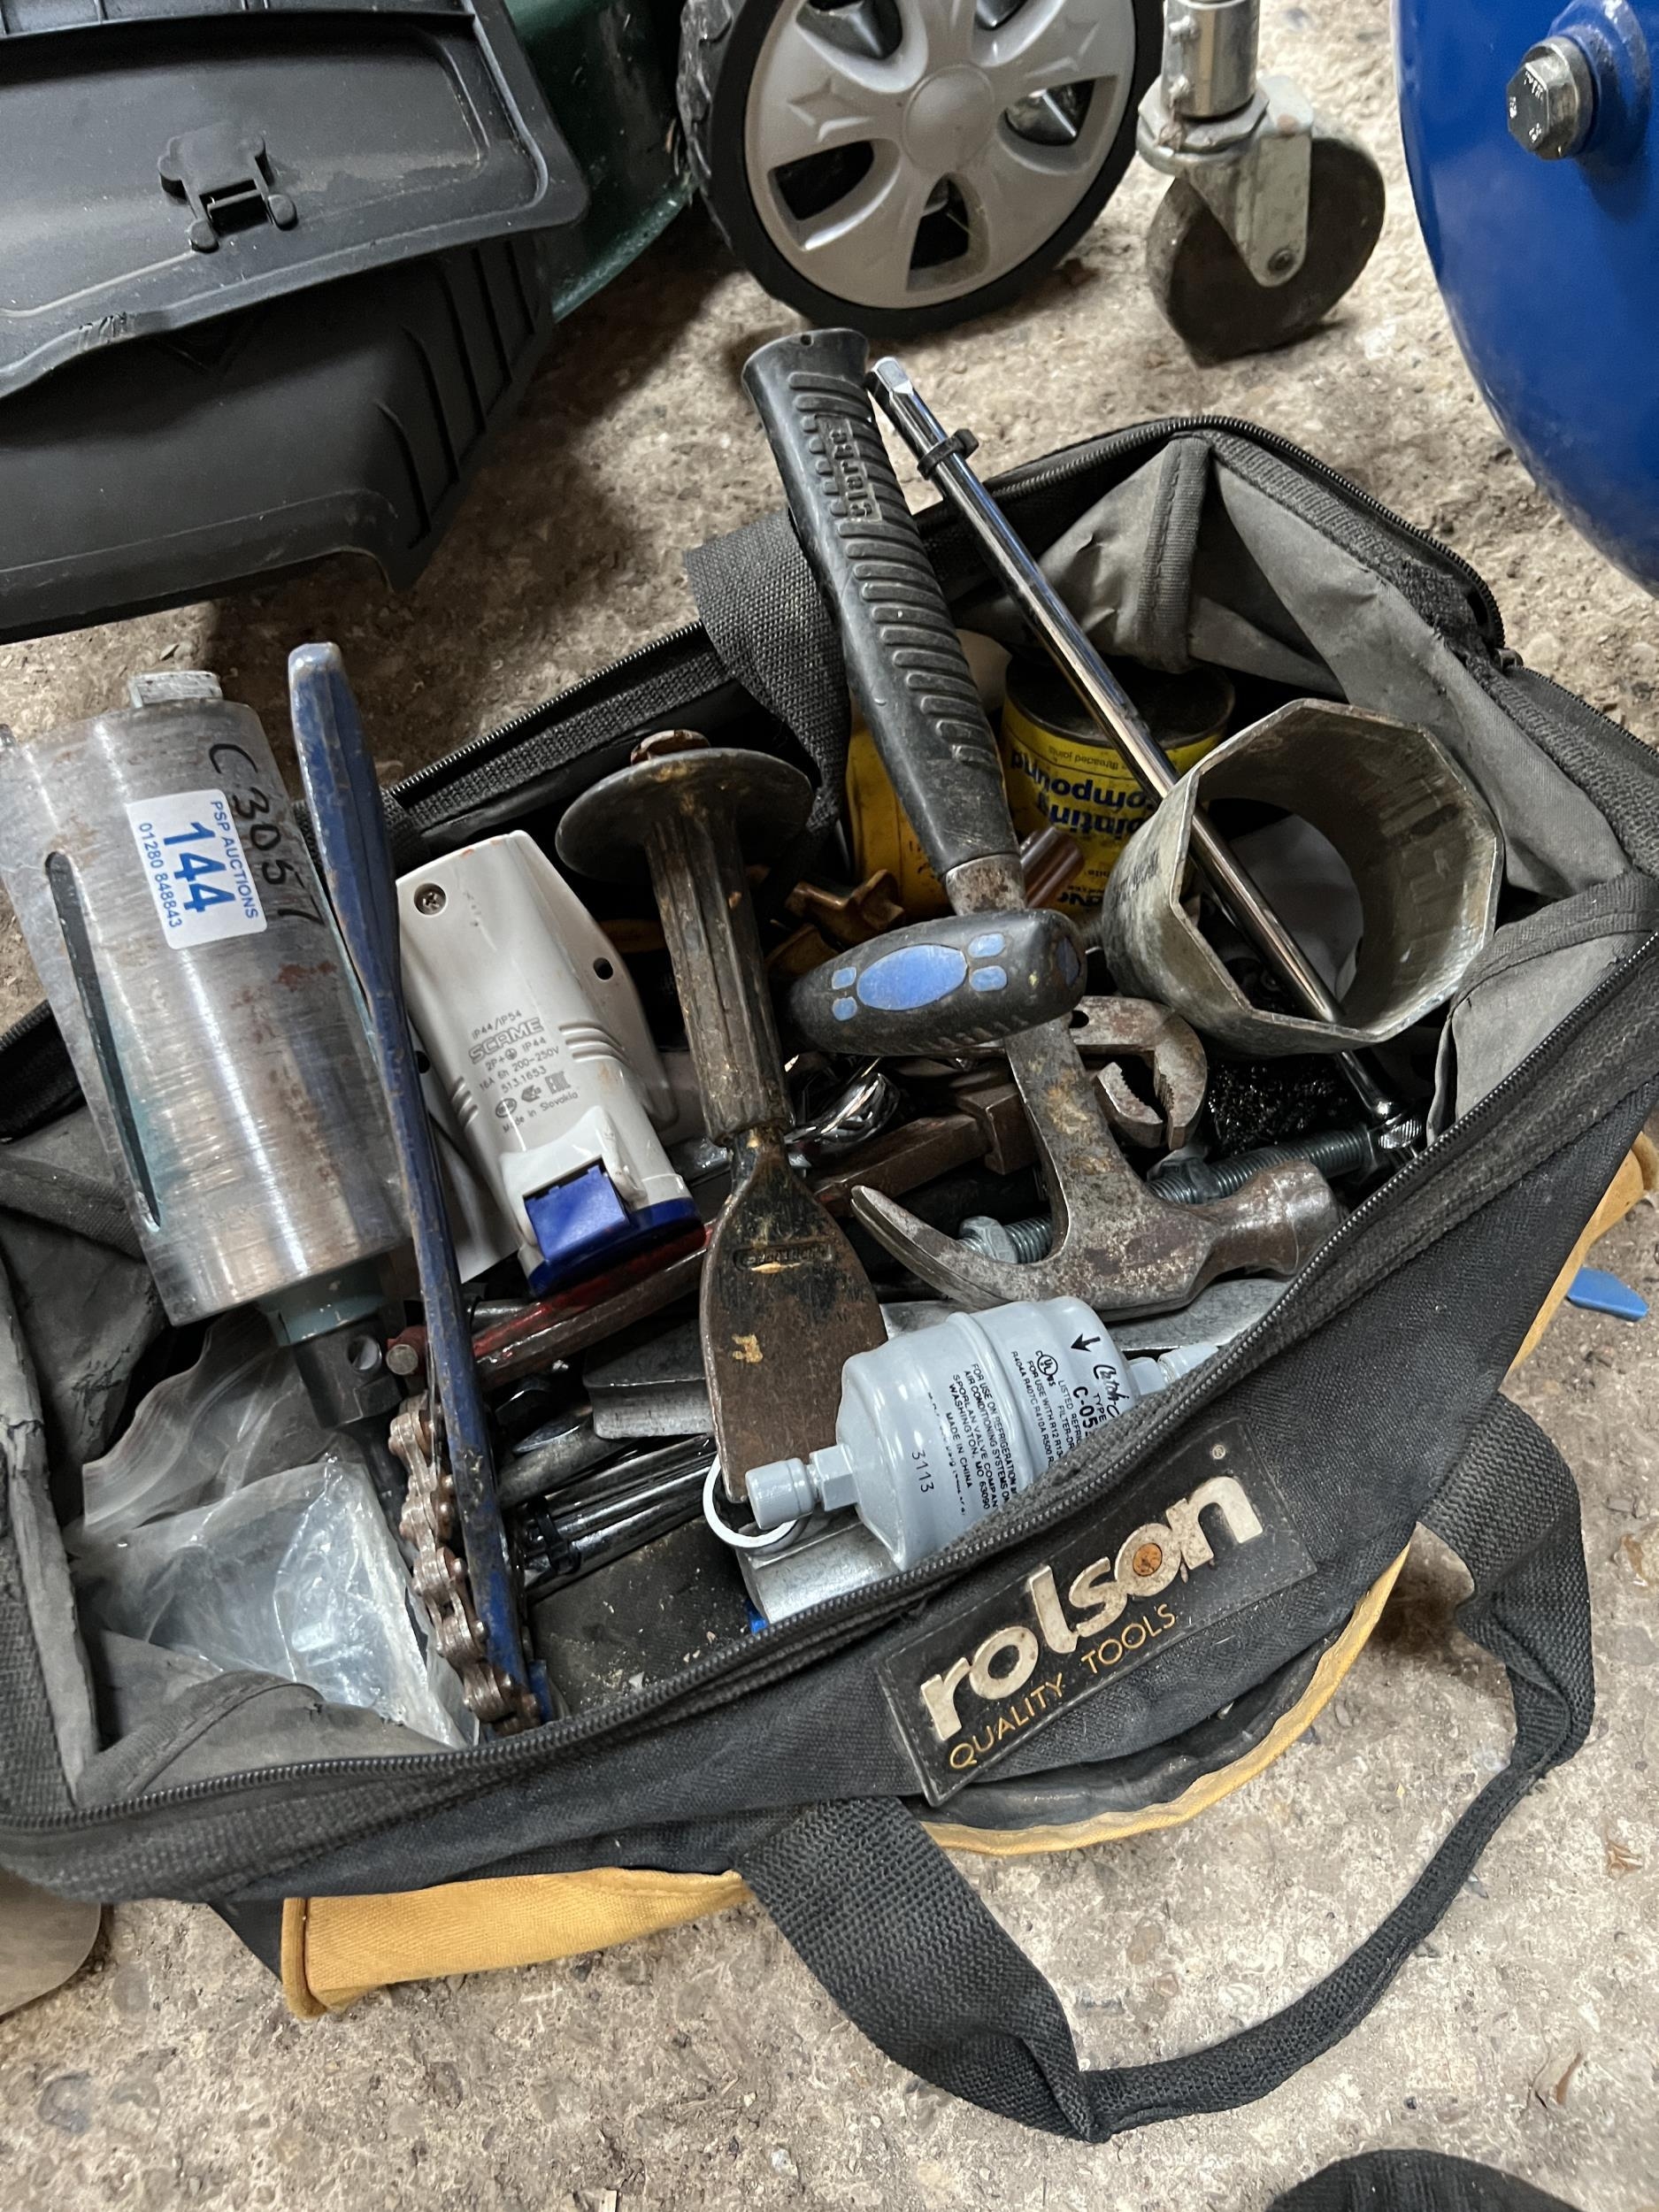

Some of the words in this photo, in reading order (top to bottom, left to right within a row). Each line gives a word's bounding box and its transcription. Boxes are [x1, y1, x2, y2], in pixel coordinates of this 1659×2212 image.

[1011, 751, 1150, 810] ompound
[1075, 755, 1118, 770] threaded
[138, 823, 165, 868] 01280
[154, 874, 182, 928] 848843
[164, 822, 235, 913] 144
[210, 801, 230, 832] PSP
[220, 836, 259, 919] AUCTIONS
[469, 1017, 544, 1064] SCAME
[522, 1036, 547, 1052] IP44
[503, 1113, 525, 1133] Mde
[527, 1108, 537, 1118] in
[541, 1091, 579, 1111] Slovakia
[1011, 1351, 1028, 1377] R404A
[1024, 1378, 1038, 1406] R407C
[1033, 1406, 1047, 1432] R410A
[1042, 1434, 1053, 1456] R500
[1027, 1360, 1039, 1379] FOR
[1035, 1379, 1047, 1397] USE
[1041, 1398, 1055, 1421] WITH
[1048, 1421, 1059, 1439] R12
[1054, 1440, 1064, 1459] R13
[1058, 1379, 1074, 1409] LISTED
[1072, 1386, 1099, 1438] C-05
[1093, 1393, 1108, 1423] TYPE
[946, 1411, 961, 1440] MADE
[949, 1384, 979, 1459] WASHINGTON,
[973, 1461, 985, 1478] MO
[979, 1480, 992, 1510] 63090
[952, 1374, 979, 1424] SPORLAN
[973, 1426, 988, 1460] VALVE
[983, 1462, 1000, 1508] COMPAN
[956, 1443, 965, 1455] IN
[964, 1370, 977, 1386] AIR
[972, 1385, 997, 1448] CONDITIONING
[992, 1448, 1009, 1489] SYSTEMS
[972, 1363, 985, 1381] FOR
[979, 1382, 993, 1400] USE
[987, 1402, 998, 1416] ON
[993, 1417, 1018, 1486] REFRIGERATION
[1056, 1404, 1075, 1450] FILTER-DR
[911, 1449, 935, 1494] 3113
[959, 1457, 974, 1489] CHINA
[920, 1475, 1263, 1743] rolson
[949, 1674, 1066, 1770] QUALITY
[1082, 1603, 1177, 1674] TOOLS
